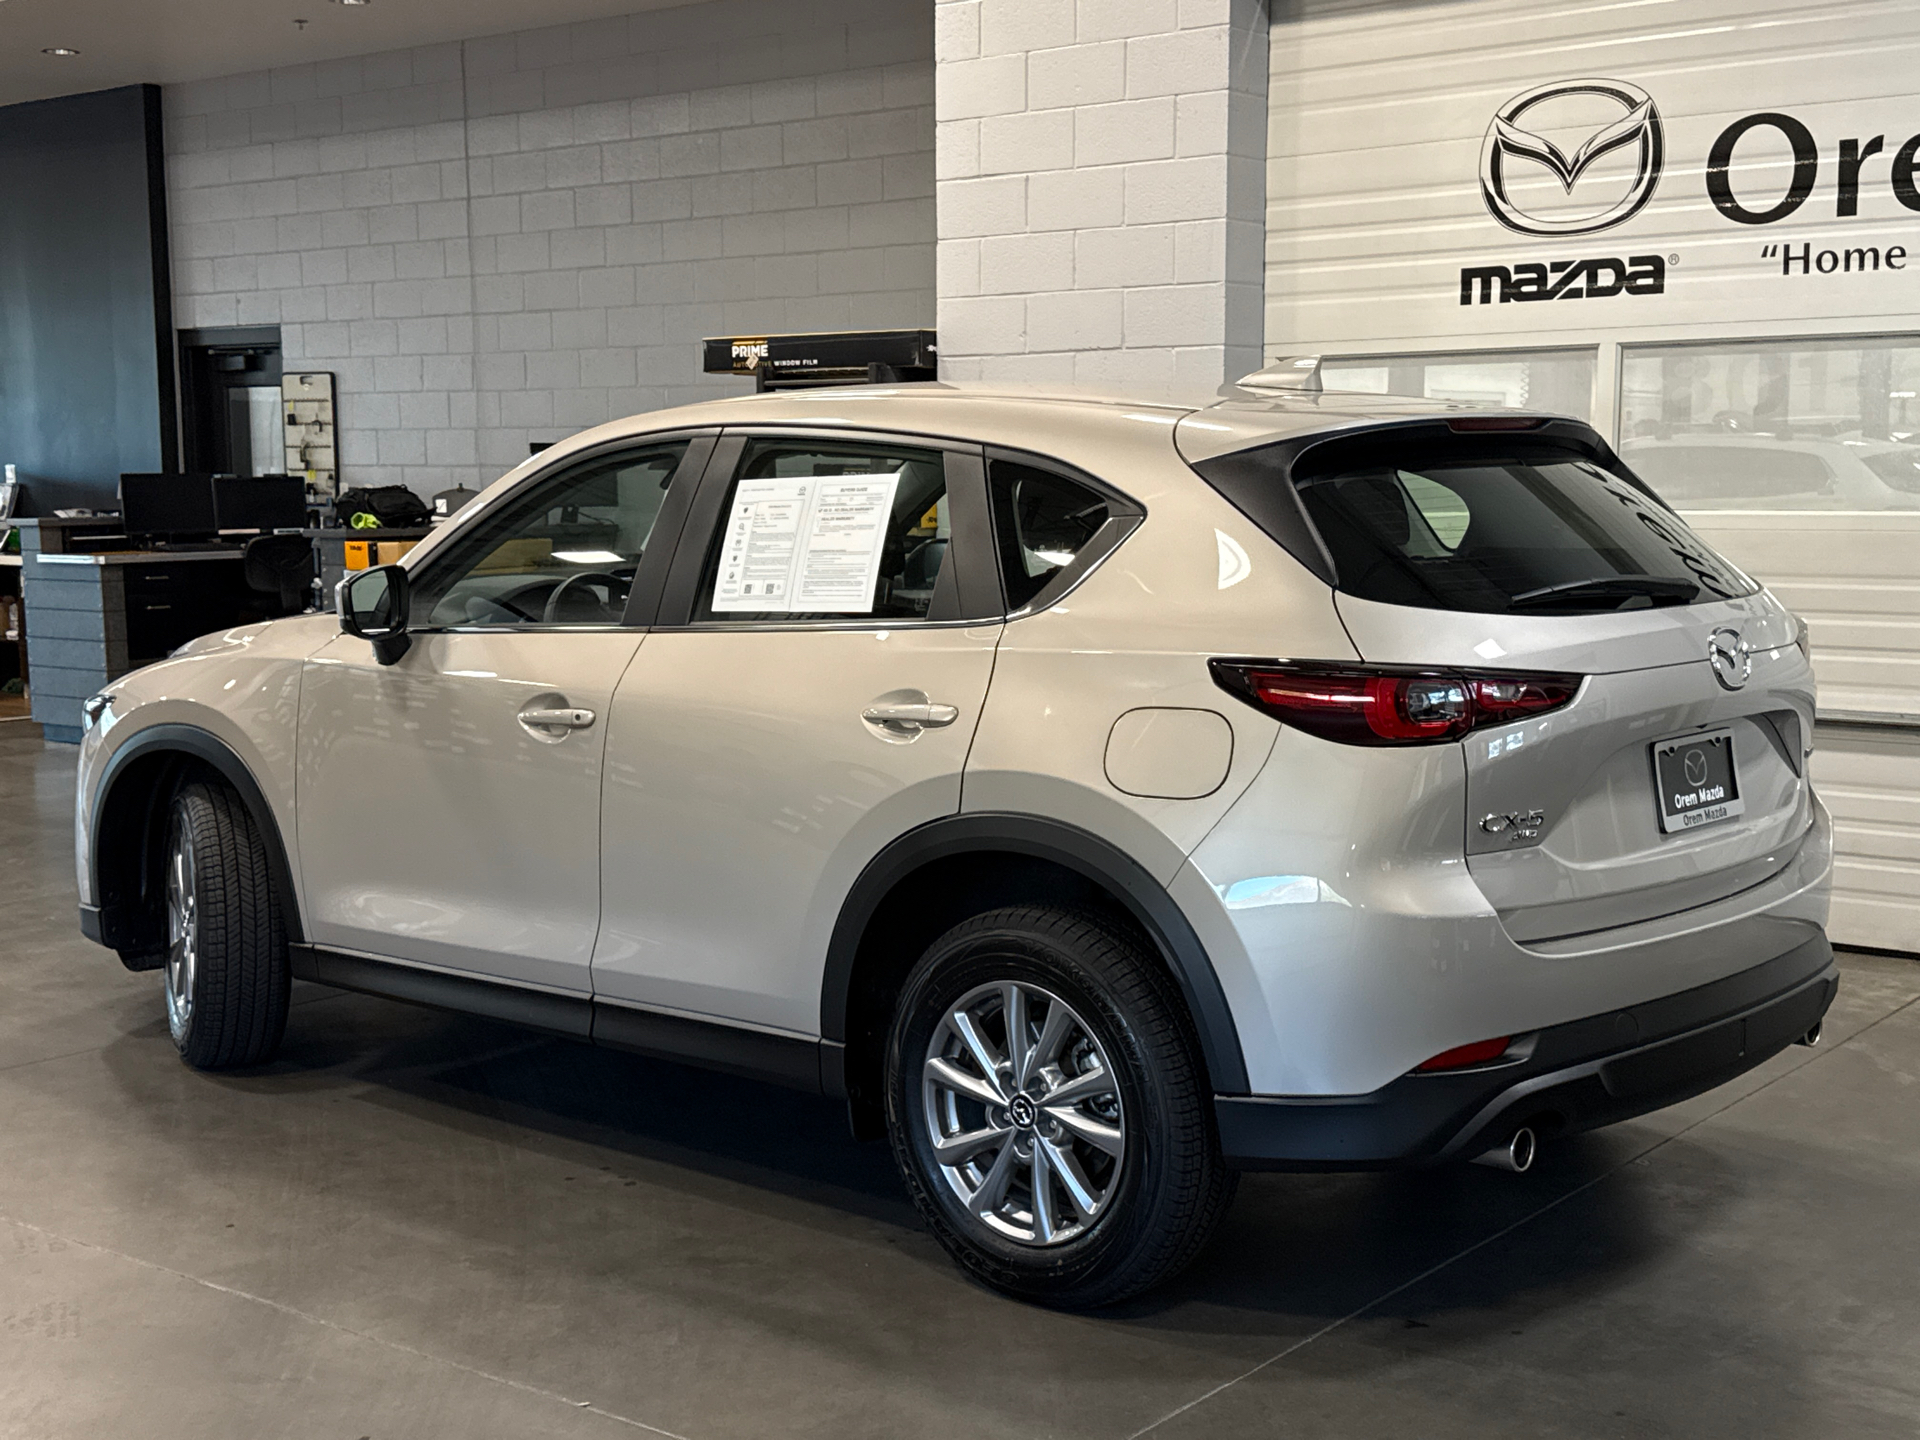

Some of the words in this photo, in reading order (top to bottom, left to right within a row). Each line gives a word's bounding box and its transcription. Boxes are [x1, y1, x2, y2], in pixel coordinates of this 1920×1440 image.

[731, 344, 769, 358] PRIME
[773, 359, 801, 367] WINDOW
[802, 358, 818, 366] FILM
[1674, 793, 1698, 809] Orem
[1698, 784, 1725, 803] Mazda
[1479, 808, 1545, 833] CX-5
[1683, 810, 1703, 826] Orem
[1703, 806, 1728, 820] Mazda
